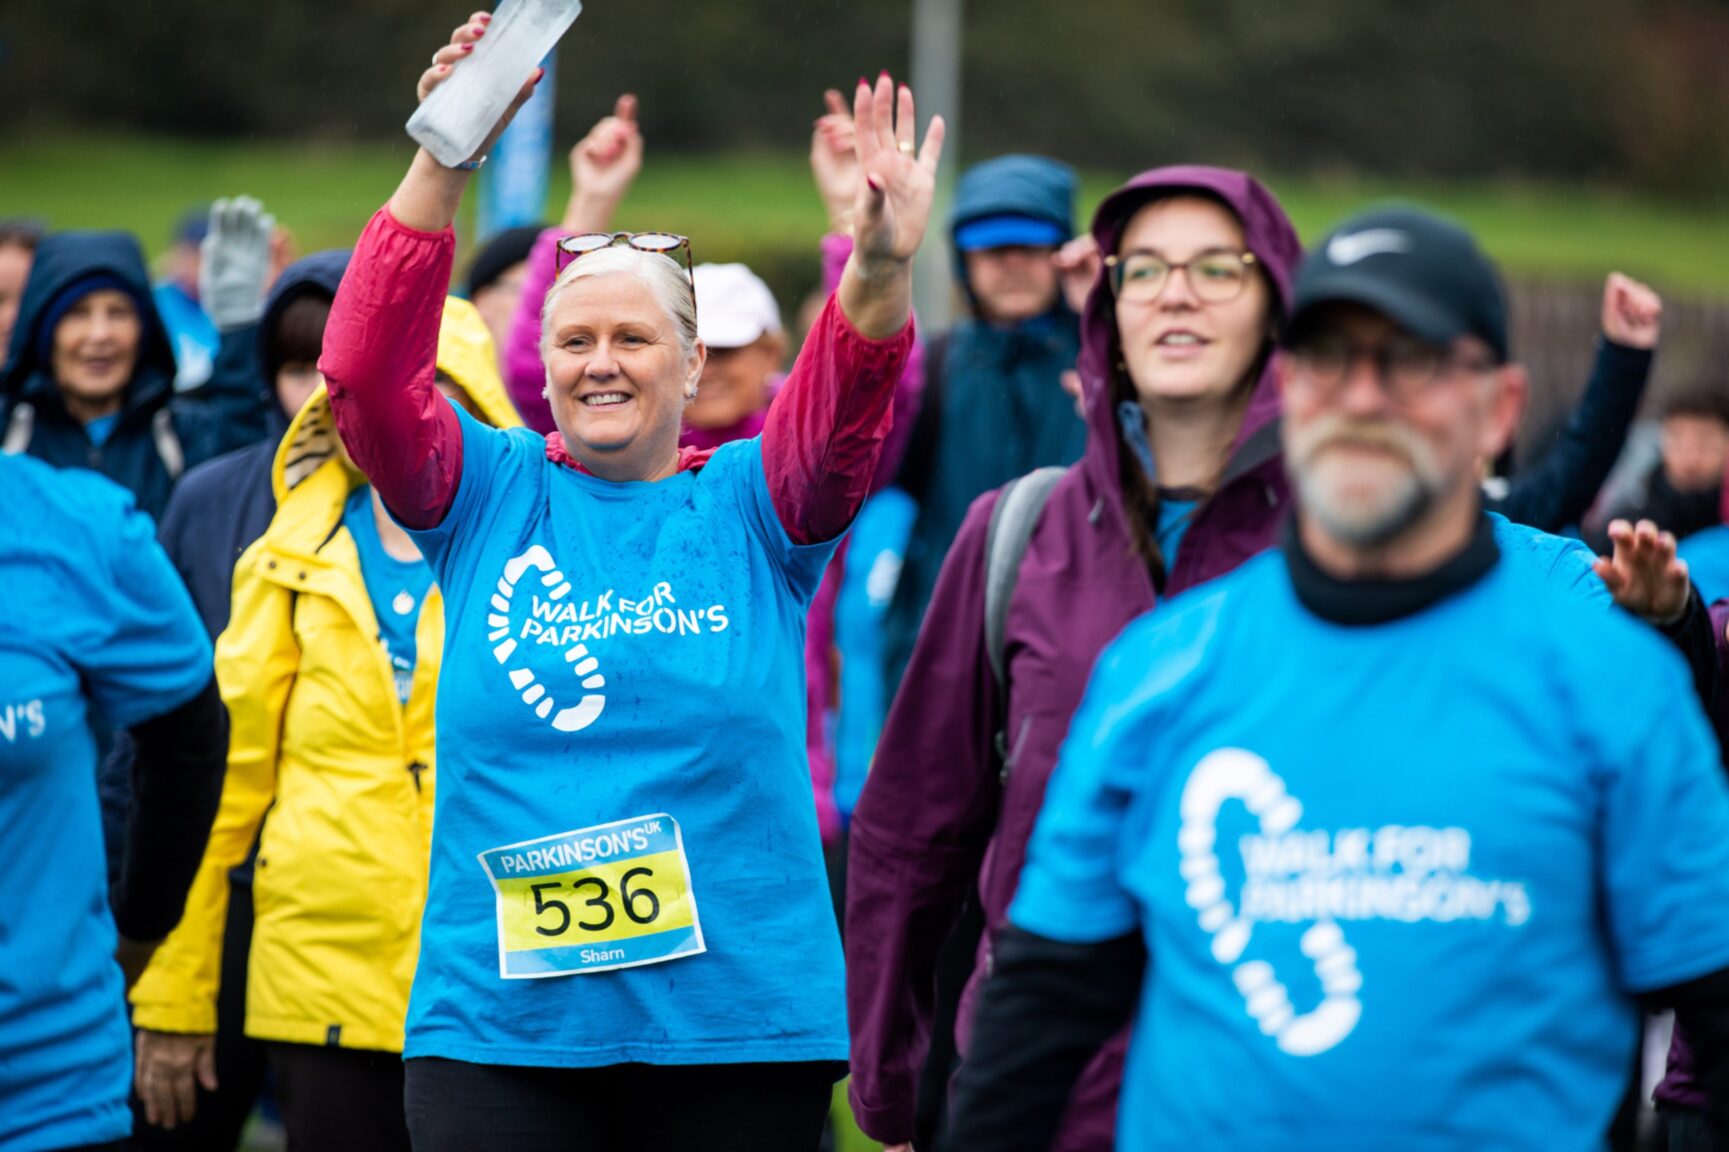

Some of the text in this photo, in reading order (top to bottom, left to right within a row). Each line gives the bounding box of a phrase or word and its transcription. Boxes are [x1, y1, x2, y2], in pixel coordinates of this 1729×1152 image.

[533, 581, 676, 623] WALK FOR
[520, 605, 729, 647] PARKINSON'S
[500, 821, 662, 874] PARKINSON'S UK
[530, 867, 660, 937] 536
[580, 948, 625, 964] Sharn
